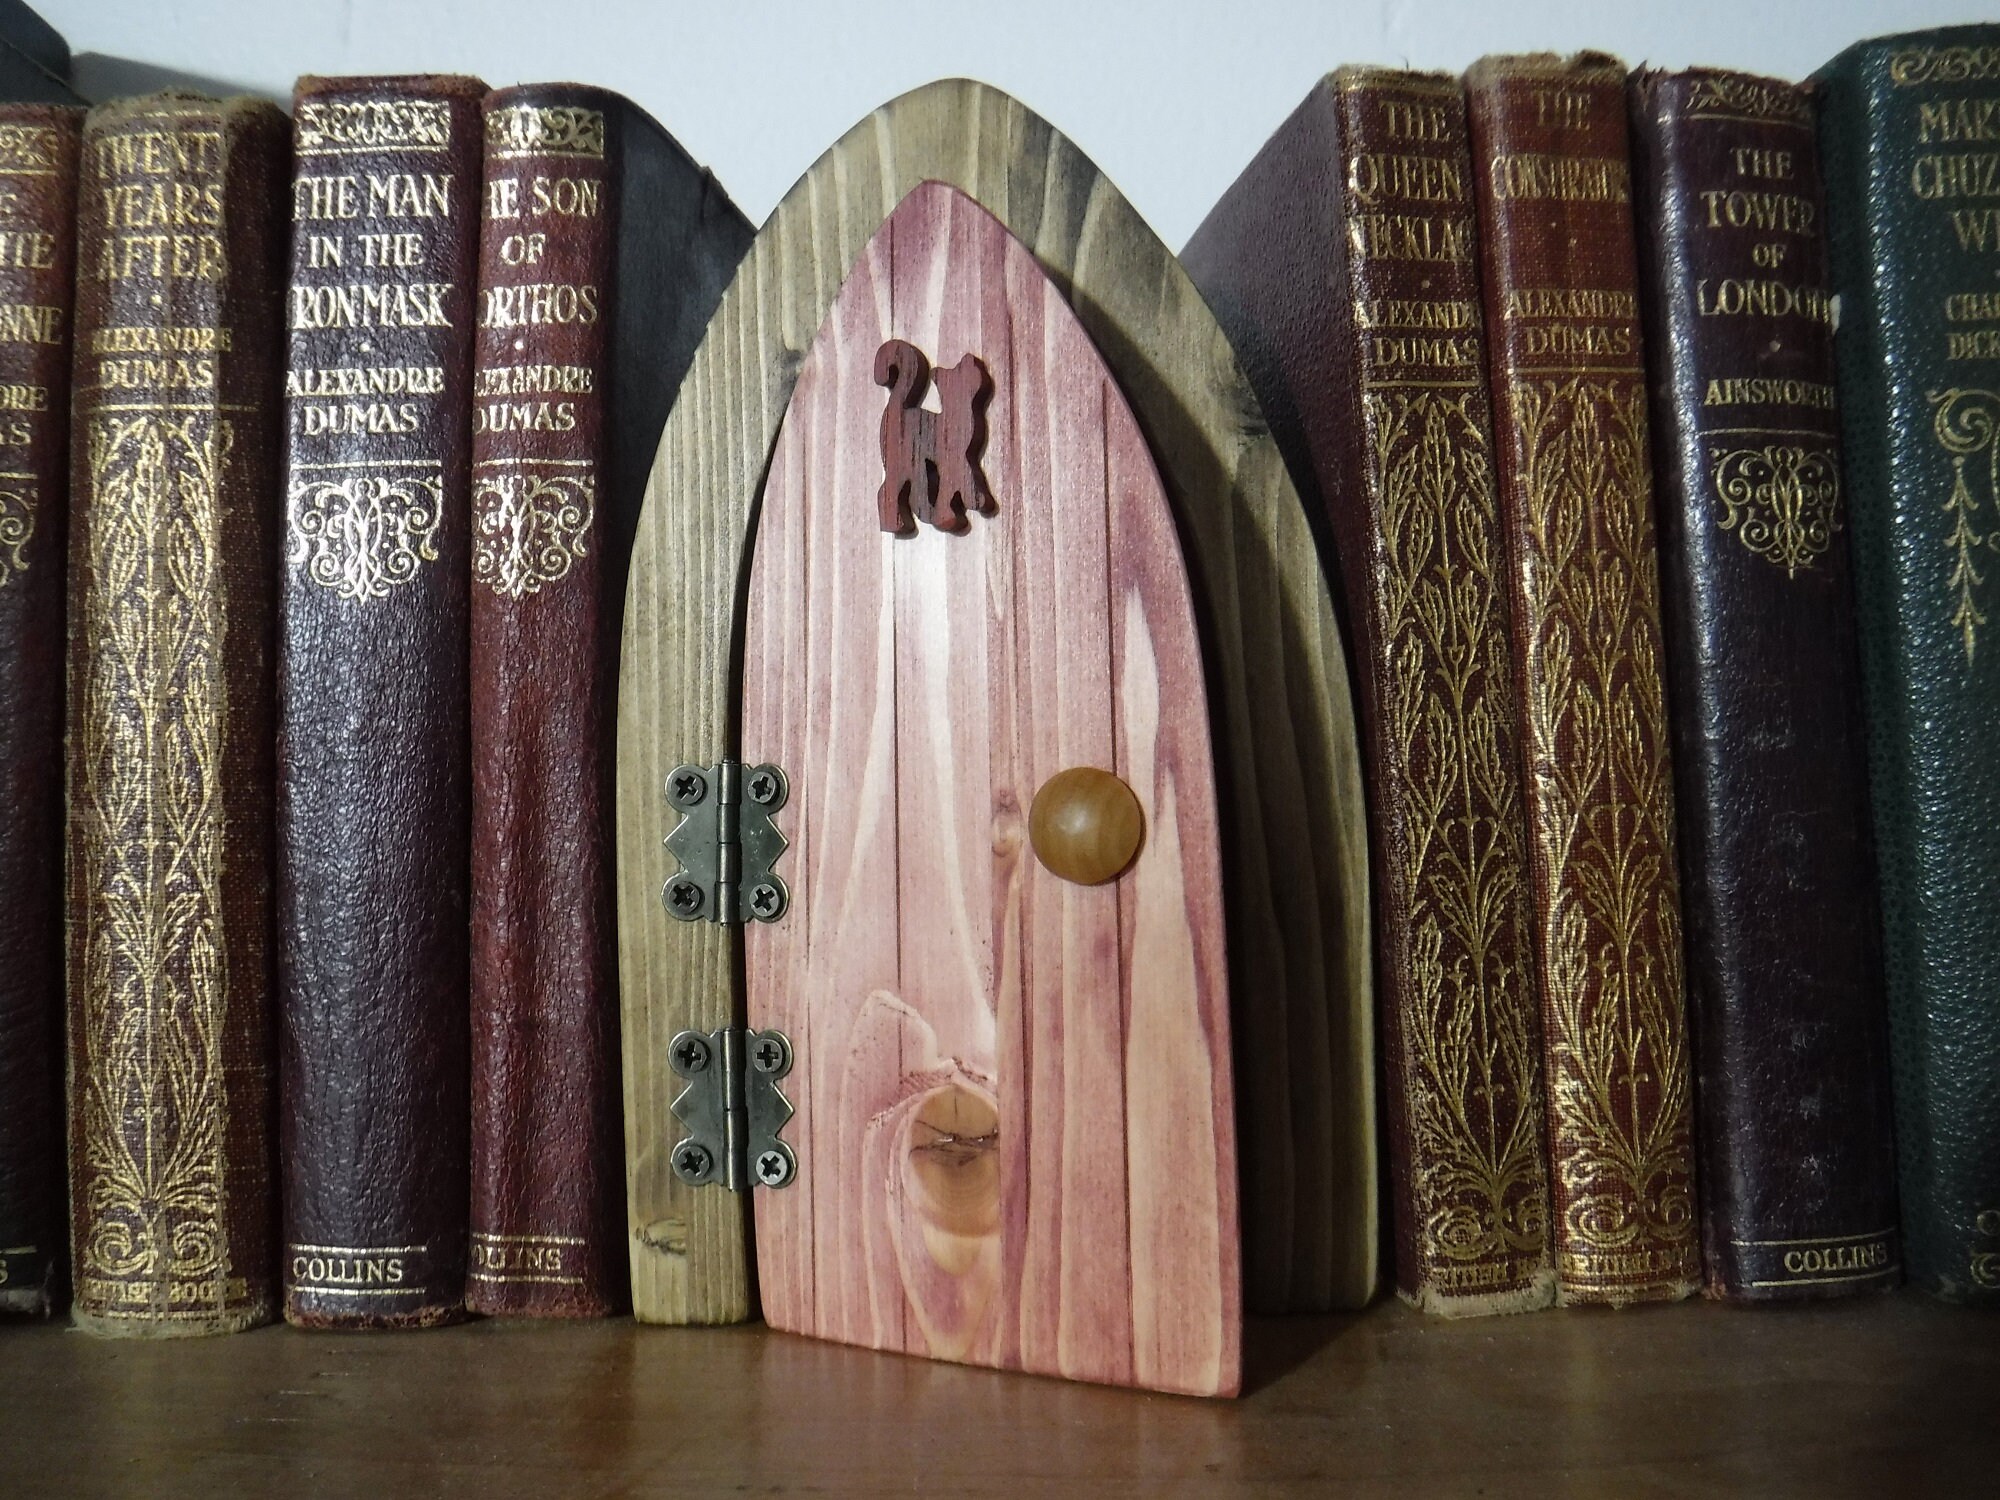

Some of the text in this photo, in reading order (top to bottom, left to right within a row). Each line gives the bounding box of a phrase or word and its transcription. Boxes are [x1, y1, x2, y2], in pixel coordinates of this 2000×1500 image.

[1379, 101, 1451, 142] THE
[1349, 154, 1463, 204] QUEEN
[1729, 147, 1795, 179] THE
[103, 184, 222, 229] YEARS
[291, 174, 454, 222] THE MAN
[531, 176, 601, 218] SON
[1700, 189, 1816, 238] TOWER
[308, 233, 425, 268] IN THE
[499, 233, 546, 266] OF
[1752, 243, 1787, 268] OF
[1373, 337, 1480, 367] DUMAS
[1526, 324, 1632, 355] DUMAS
[99, 360, 214, 390] DUMAS
[285, 367, 445, 397] ALEXANDRE
[1703, 378, 1836, 409] AINSWORTH
[304, 404, 420, 436] DUMAS
[292, 1256, 403, 1283] COLLINS
[1784, 1242, 1888, 1274] COLLINS
